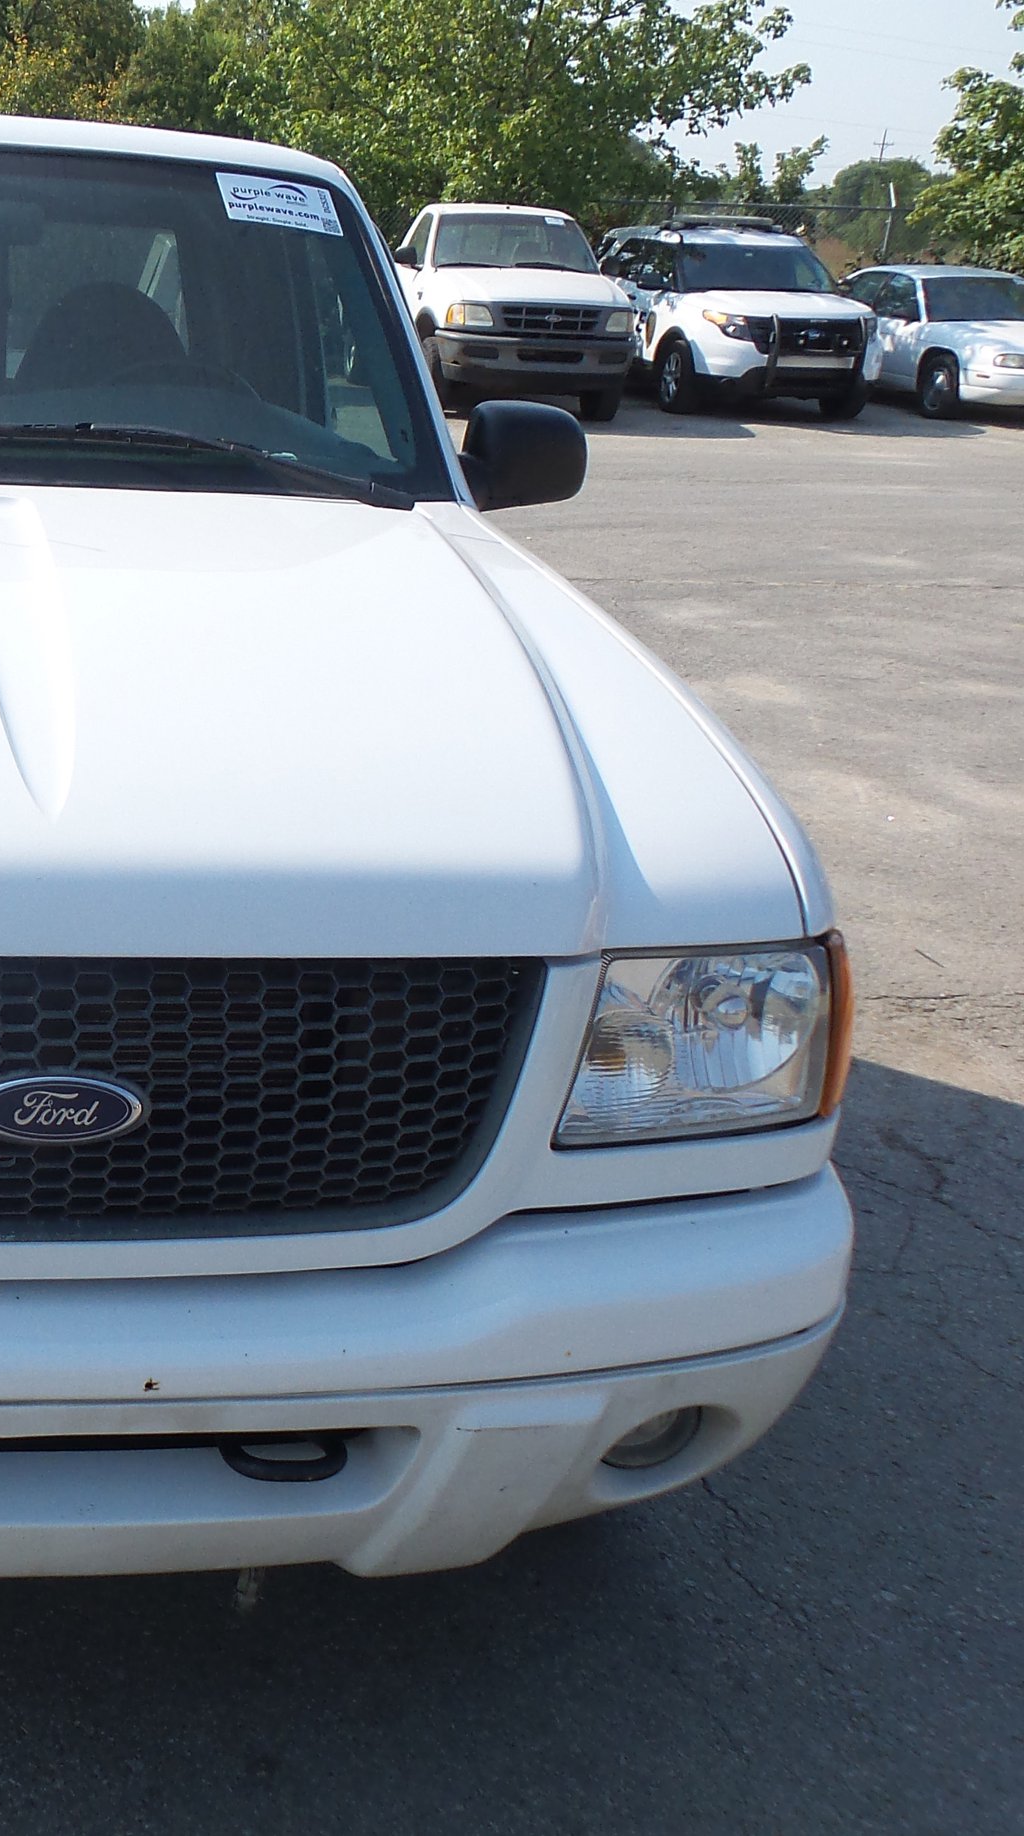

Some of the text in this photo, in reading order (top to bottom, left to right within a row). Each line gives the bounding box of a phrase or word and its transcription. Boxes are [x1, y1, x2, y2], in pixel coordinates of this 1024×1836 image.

[232, 186, 271, 197] purple
[275, 192, 306, 203] wave
[228, 201, 320, 220] purplewave.com
[14, 1090, 100, 1126] Ford
